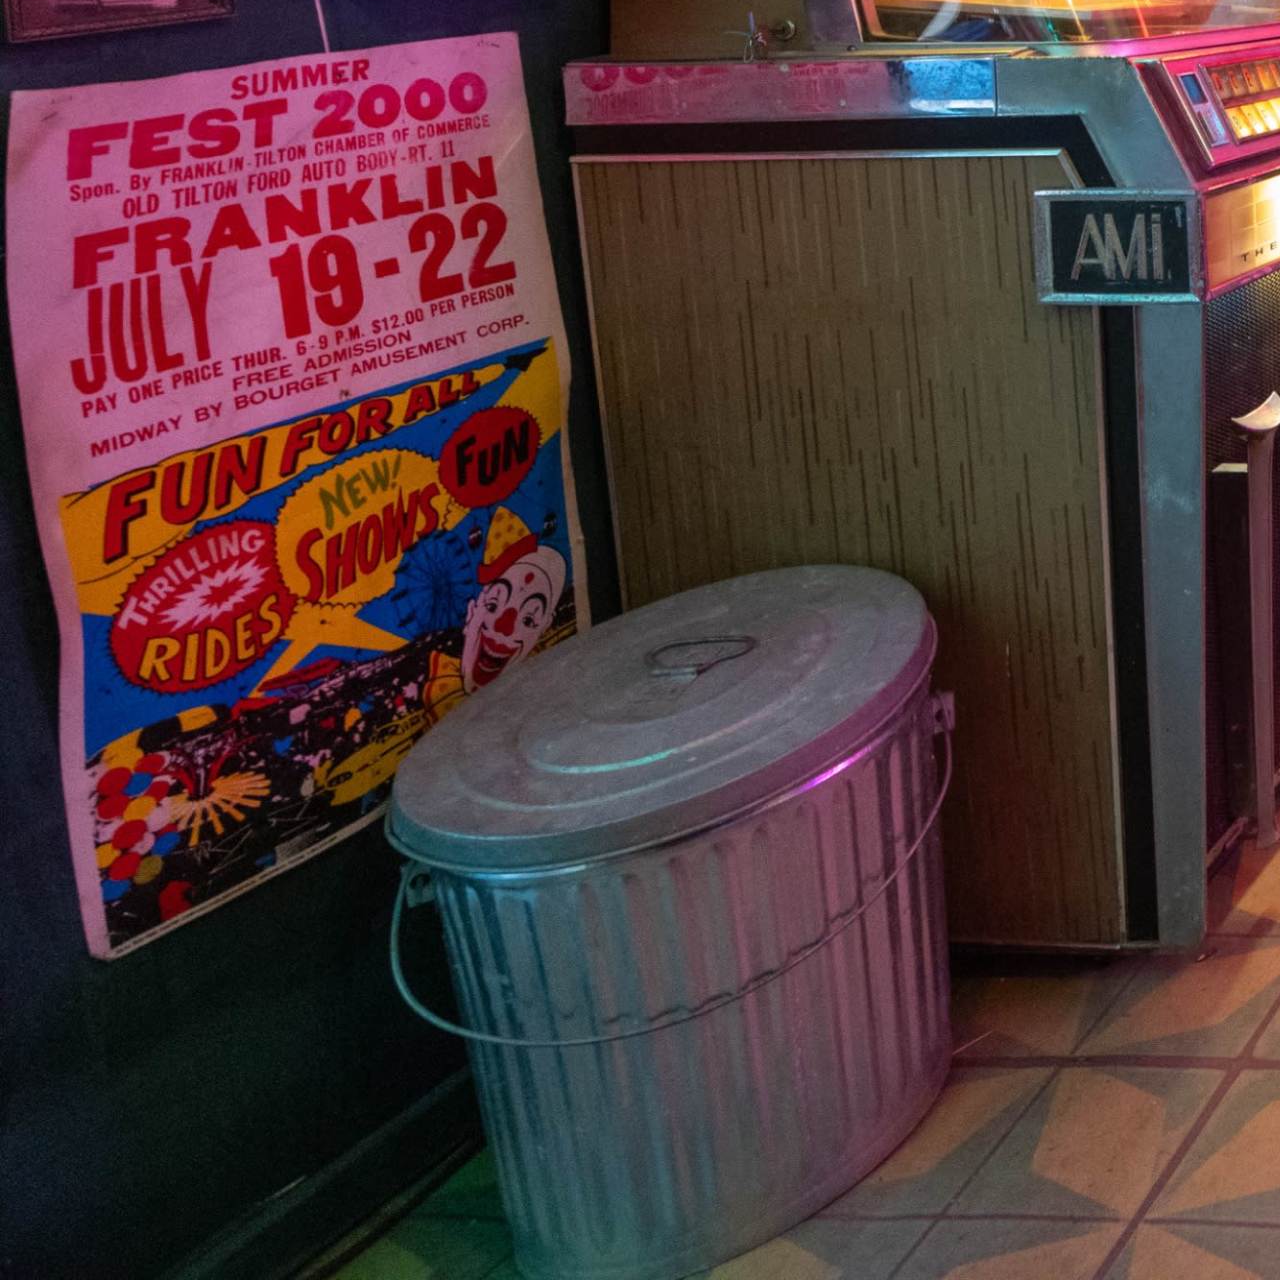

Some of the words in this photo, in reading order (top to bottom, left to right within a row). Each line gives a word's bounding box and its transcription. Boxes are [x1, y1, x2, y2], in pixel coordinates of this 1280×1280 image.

[67, 98, 288, 181] FEST
[313, 72, 488, 138] 2000
[231, 59, 370, 100] SUMMER
[70, 182, 120, 202] Spon.
[130, 174, 151, 191] By
[314, 131, 385, 156] CHAMBER
[392, 127, 410, 143] OF
[417, 115, 491, 139] COMMERCE
[122, 194, 159, 219] OLD
[171, 180, 237, 209] TILTON
[248, 168, 291, 194] FORD
[302, 159, 345, 183] AUTO
[441, 140, 455, 159] 11
[73, 156, 497, 289] FRANKLIN
[1240, 240, 1278, 263] THE
[70, 262, 213, 395] JULY
[82, 392, 117, 418] PAY
[128, 379, 165, 404] ONE
[172, 361, 224, 390] PRICE
[231, 347, 287, 372] THUR.
[335, 327, 366, 346] P.M.
[371, 309, 424, 334] $12.00
[430, 299, 457, 317] PER
[462, 283, 515, 308] PERSON
[231, 363, 293, 391] FREE
[304, 330, 412, 372] ADMISSION
[90, 415, 183, 458] MIDWAY
[194, 402, 223, 424] BY
[234, 368, 341, 411] BOURGET
[350, 331, 467, 377] AMUSEMENT
[476, 313, 530, 338] CORP.
[104, 433, 266, 564] FUN
[279, 390, 393, 477] FOR
[403, 371, 480, 423] ALL
[318, 453, 403, 531] NEW!
[455, 420, 530, 487] FUN
[116, 527, 266, 631] THRILLING
[295, 482, 442, 603] SHOWS
[139, 596, 281, 683] RIDES
